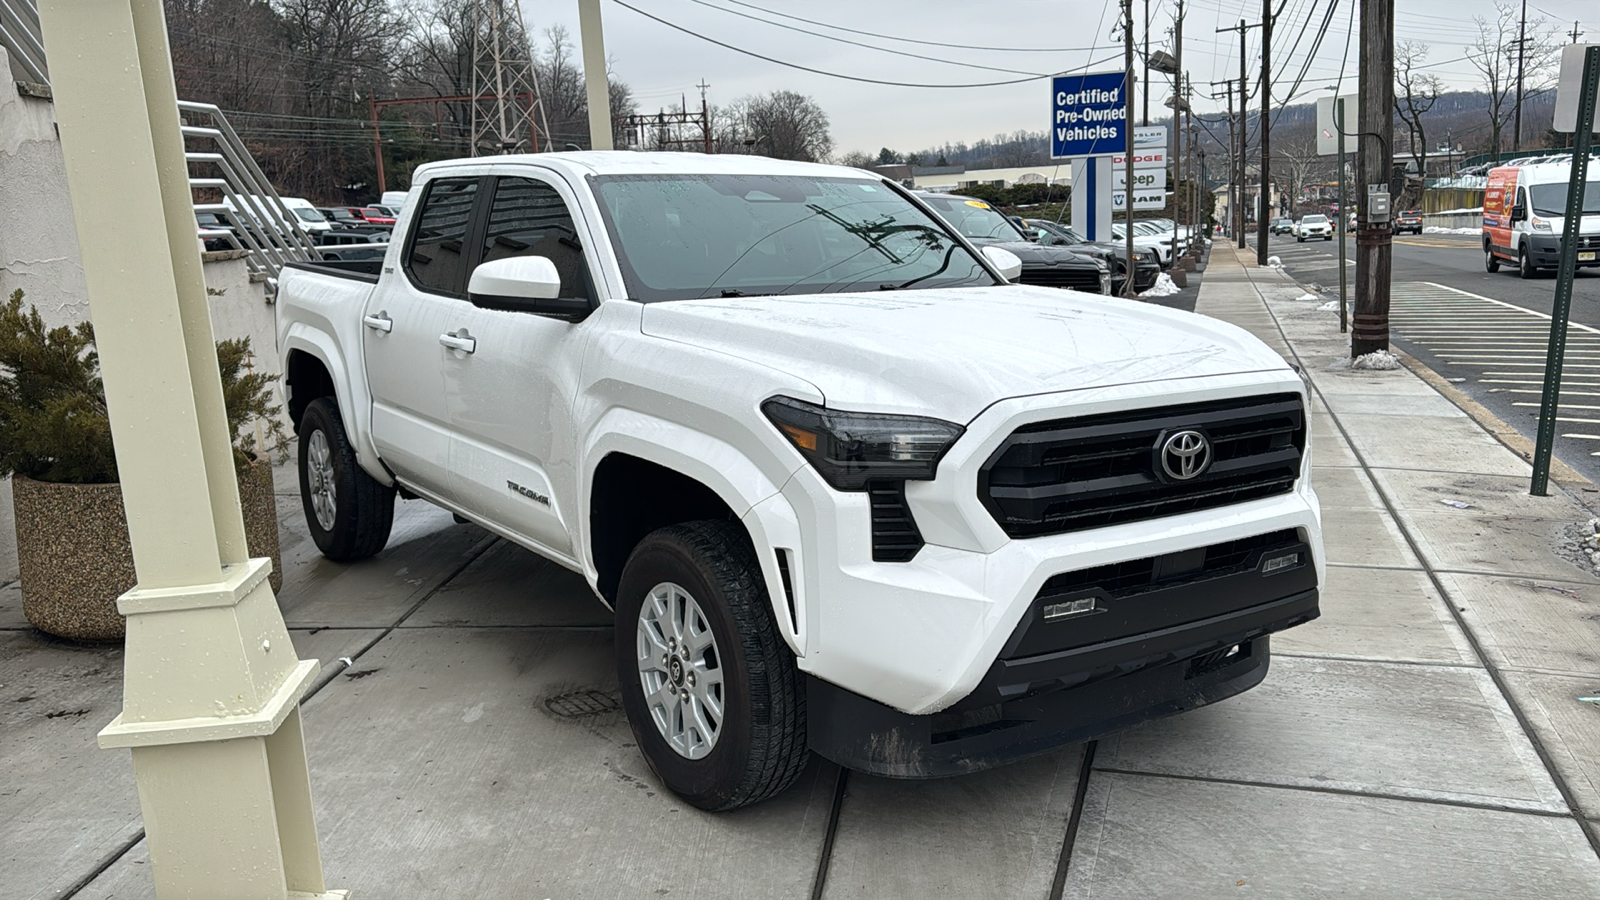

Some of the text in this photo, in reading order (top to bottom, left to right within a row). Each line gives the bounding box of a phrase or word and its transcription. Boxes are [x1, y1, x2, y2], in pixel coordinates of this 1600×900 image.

[1056, 87, 1118, 106] Certified
[1056, 105, 1126, 124] Pre-Owned
[1056, 125, 1117, 141] Vehicles
[1113, 155, 1163, 163] DDGE
[506, 479, 551, 508] TACOMA
